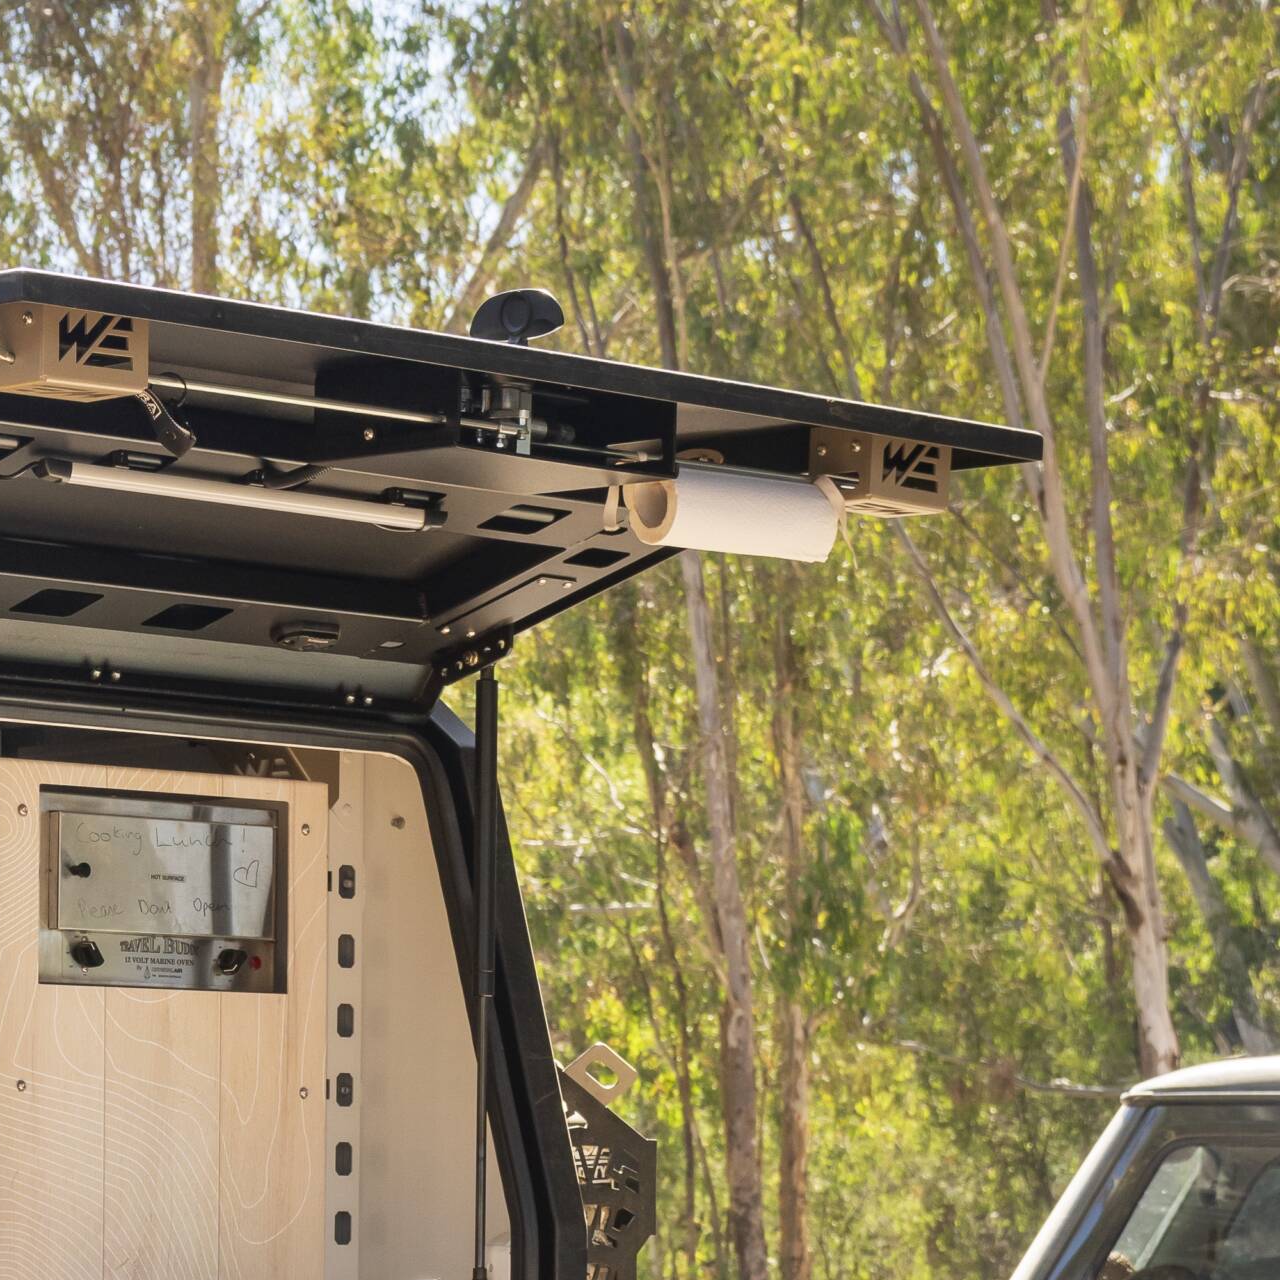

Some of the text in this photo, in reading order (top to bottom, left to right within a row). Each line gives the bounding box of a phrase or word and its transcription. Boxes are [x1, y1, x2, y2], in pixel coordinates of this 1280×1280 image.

[76, 822, 142, 856] Cooking
[150, 873, 161, 881] HOT
[120, 934, 160, 953] TRAVEL
[132, 956, 149, 964] VOLT
